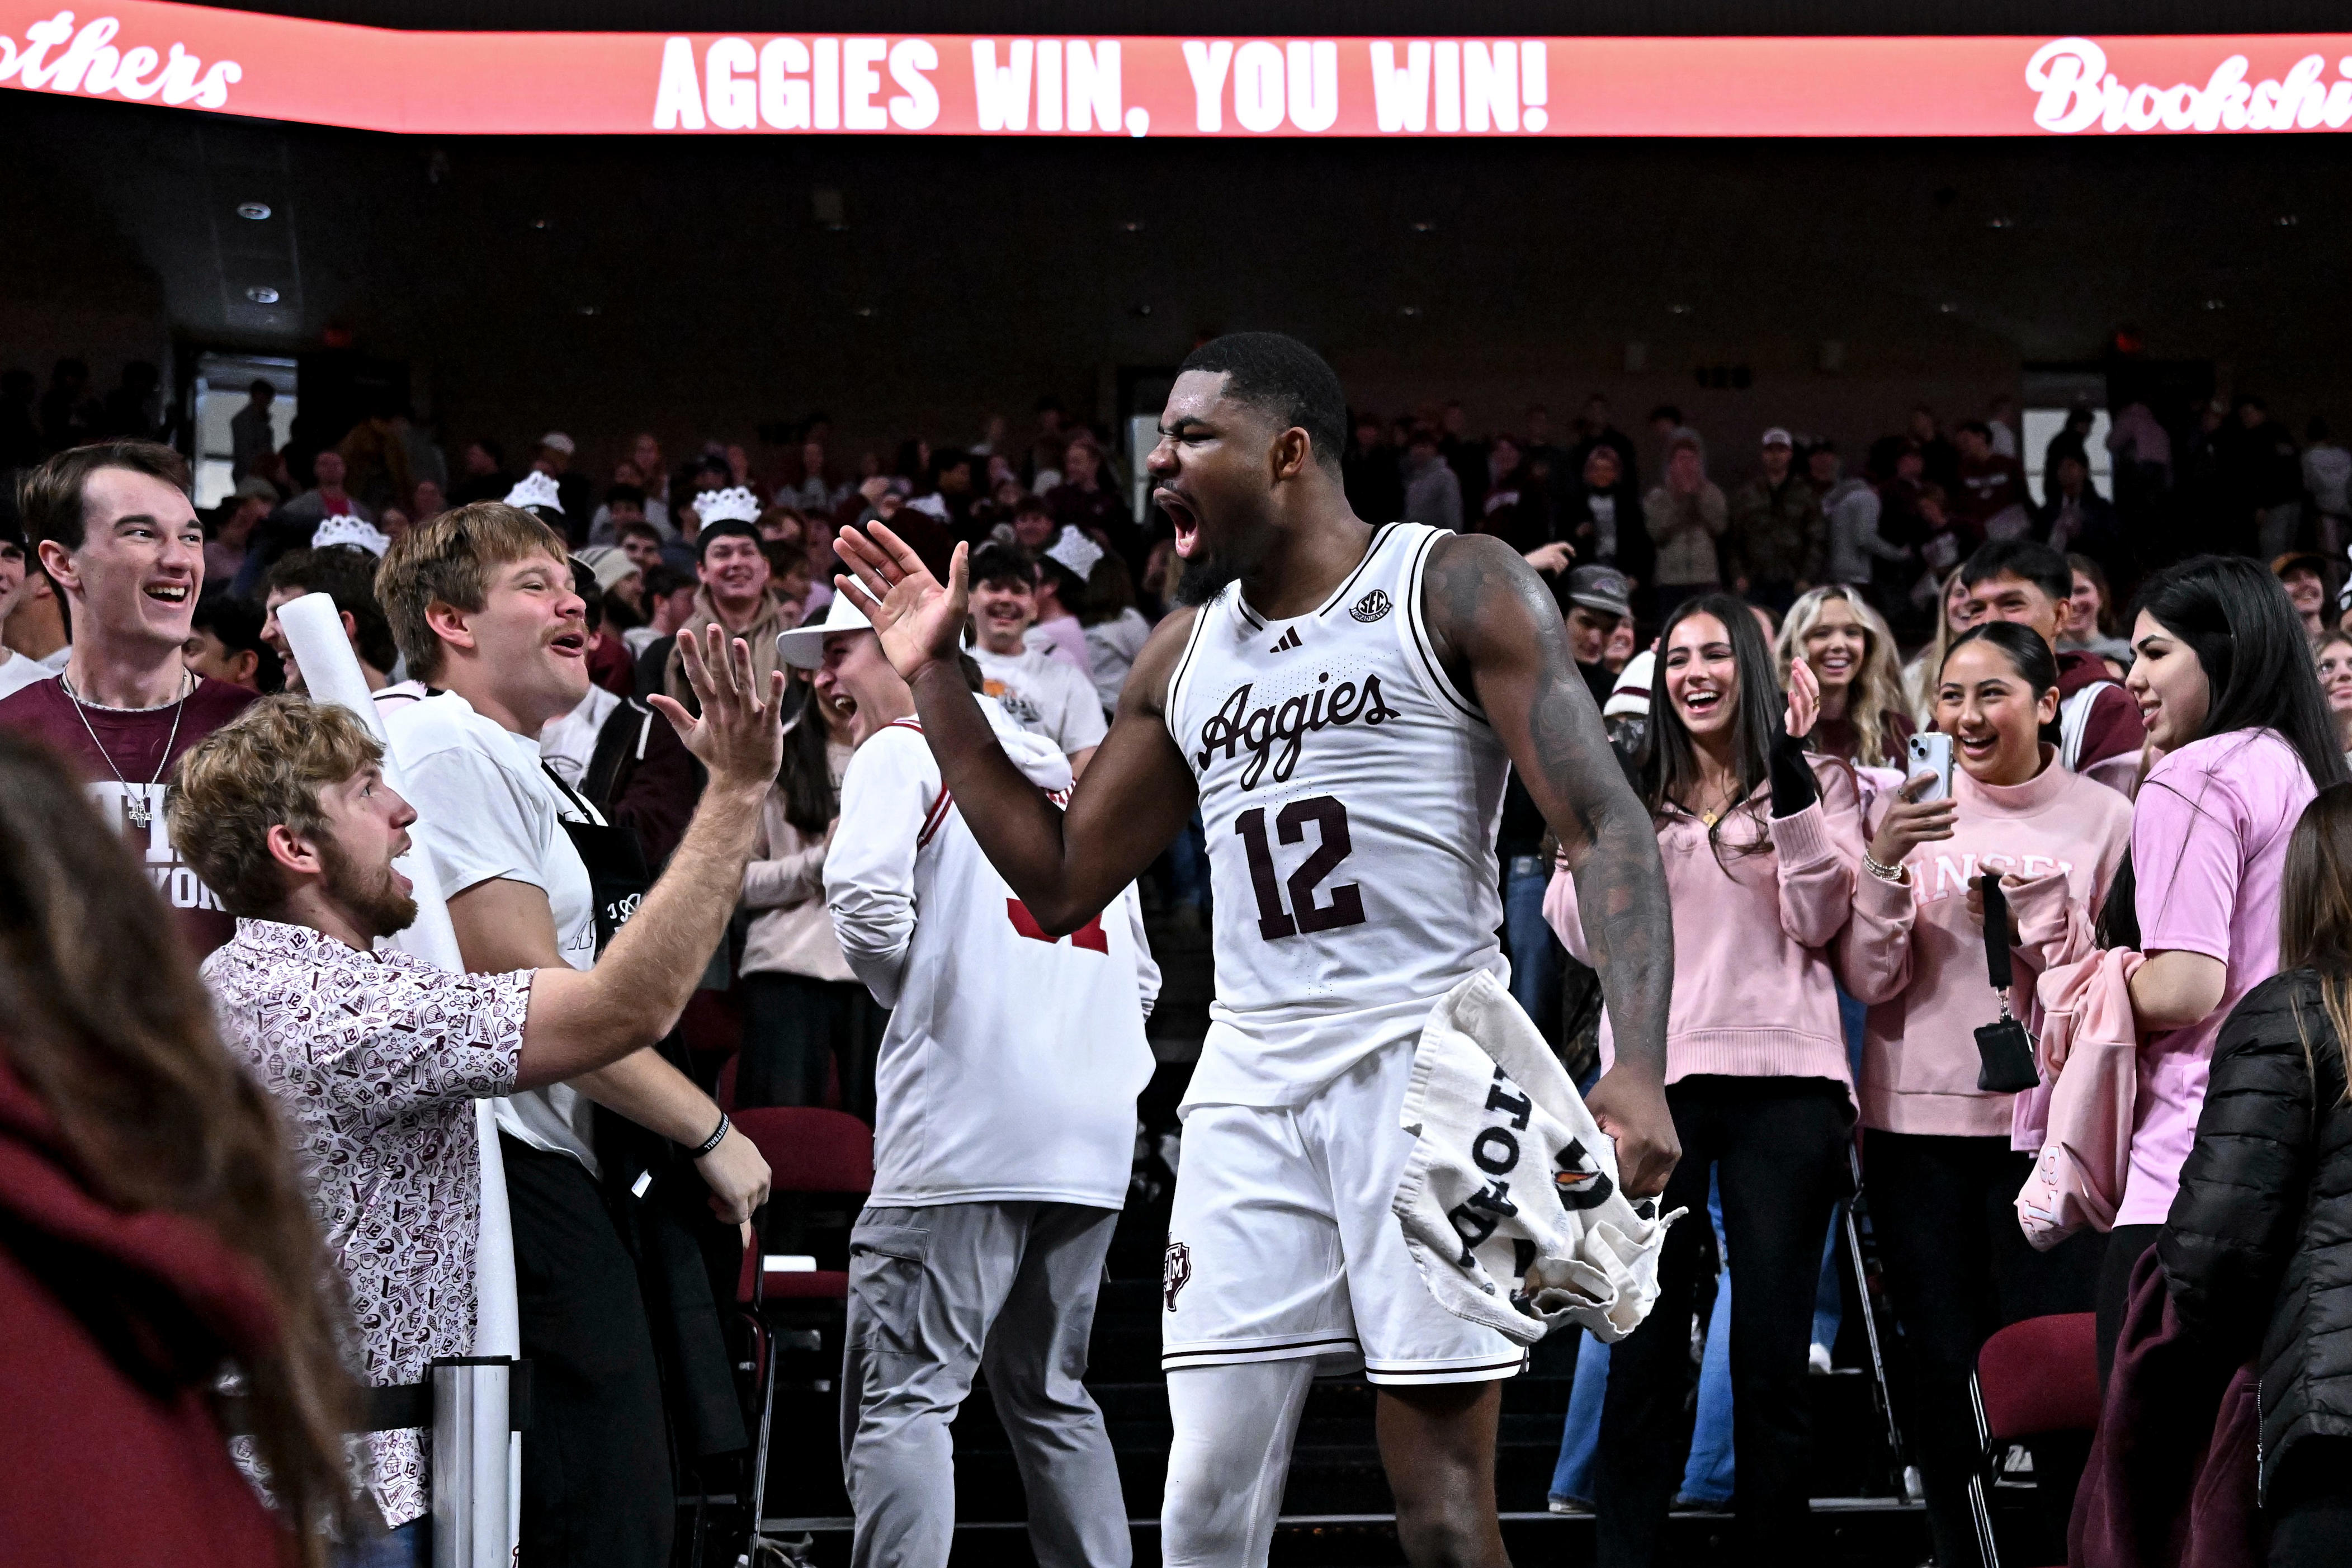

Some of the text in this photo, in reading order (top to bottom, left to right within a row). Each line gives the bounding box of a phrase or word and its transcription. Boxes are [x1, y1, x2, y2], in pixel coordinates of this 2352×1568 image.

[652, 36, 1549, 138] AGGIES WIN, YOU WIN!
[1360, 591, 1385, 613] SEC
[1197, 671, 1401, 792] Aggies
[1235, 795, 1366, 941] 12
[290, 933, 305, 948] 12
[288, 993, 301, 1007] 12
[343, 1028, 357, 1043] 12
[409, 1046, 424, 1060] 12
[290, 1068, 303, 1080] 12
[489, 1062, 505, 1076] 12
[356, 1089, 371, 1102] 12
[314, 1138, 327, 1152] 12
[384, 1154, 399, 1169] 12
[334, 1208, 347, 1221] 12
[366, 1222, 382, 1238] 12
[354, 1297, 370, 1312] 12
[442, 1338, 454, 1352] 12
[405, 1462, 417, 1476] 12
